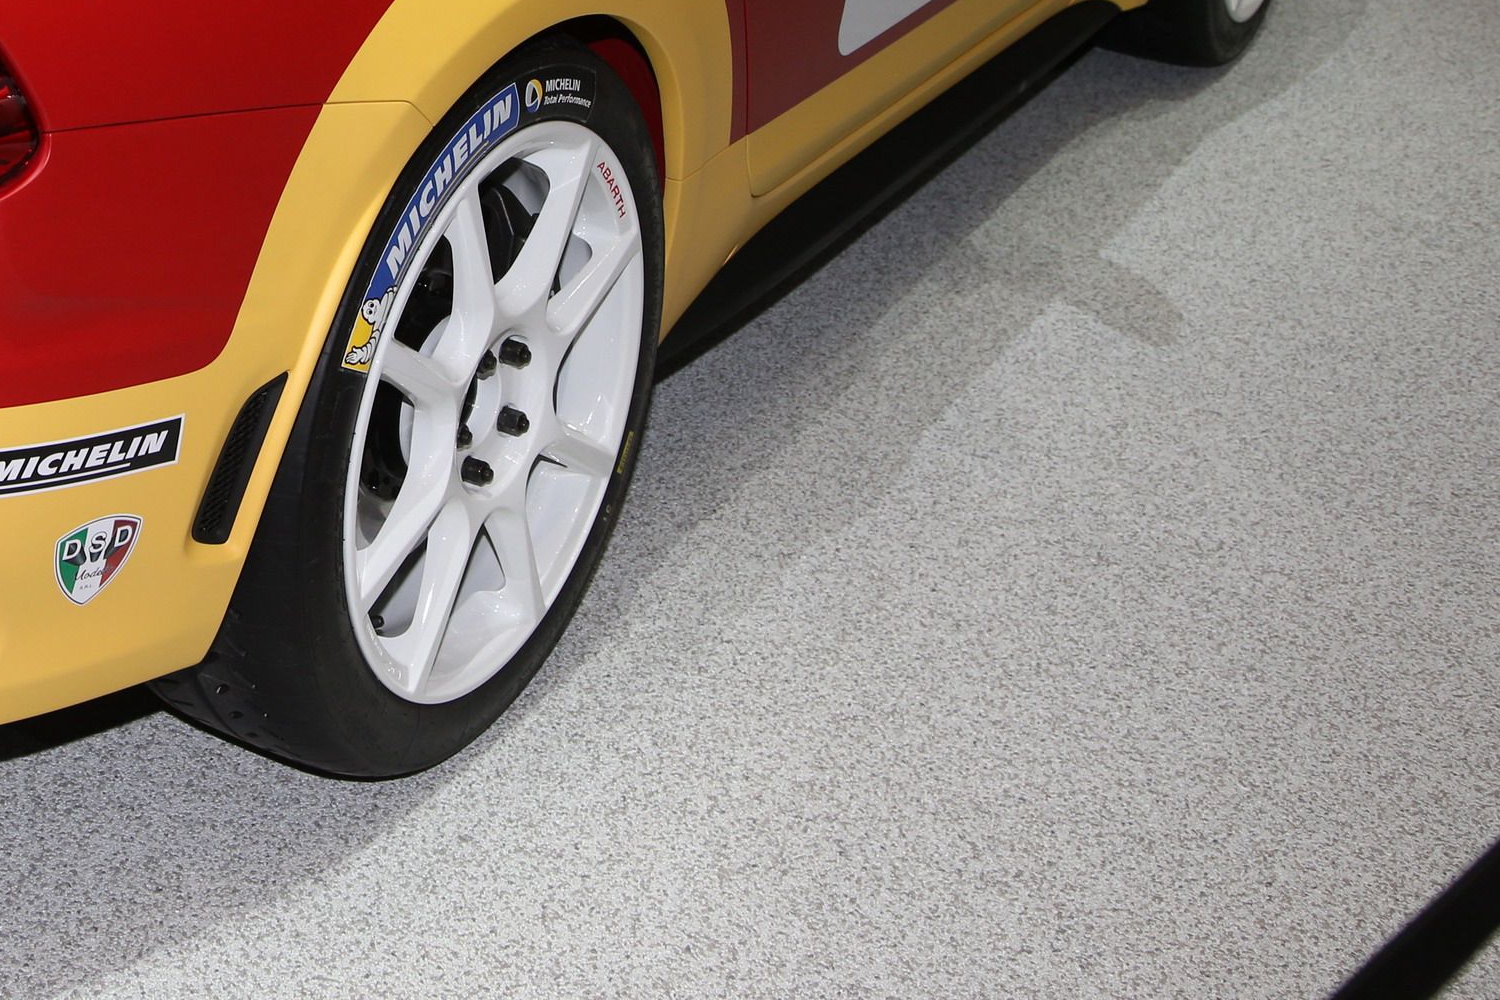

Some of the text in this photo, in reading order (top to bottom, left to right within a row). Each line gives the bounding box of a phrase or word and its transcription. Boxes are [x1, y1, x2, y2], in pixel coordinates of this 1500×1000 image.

[545, 78, 581, 93] MICHELIN
[385, 92, 515, 280] MICHELIN
[596, 160, 627, 219] ABARTH
[62, 525, 133, 561] DSD
